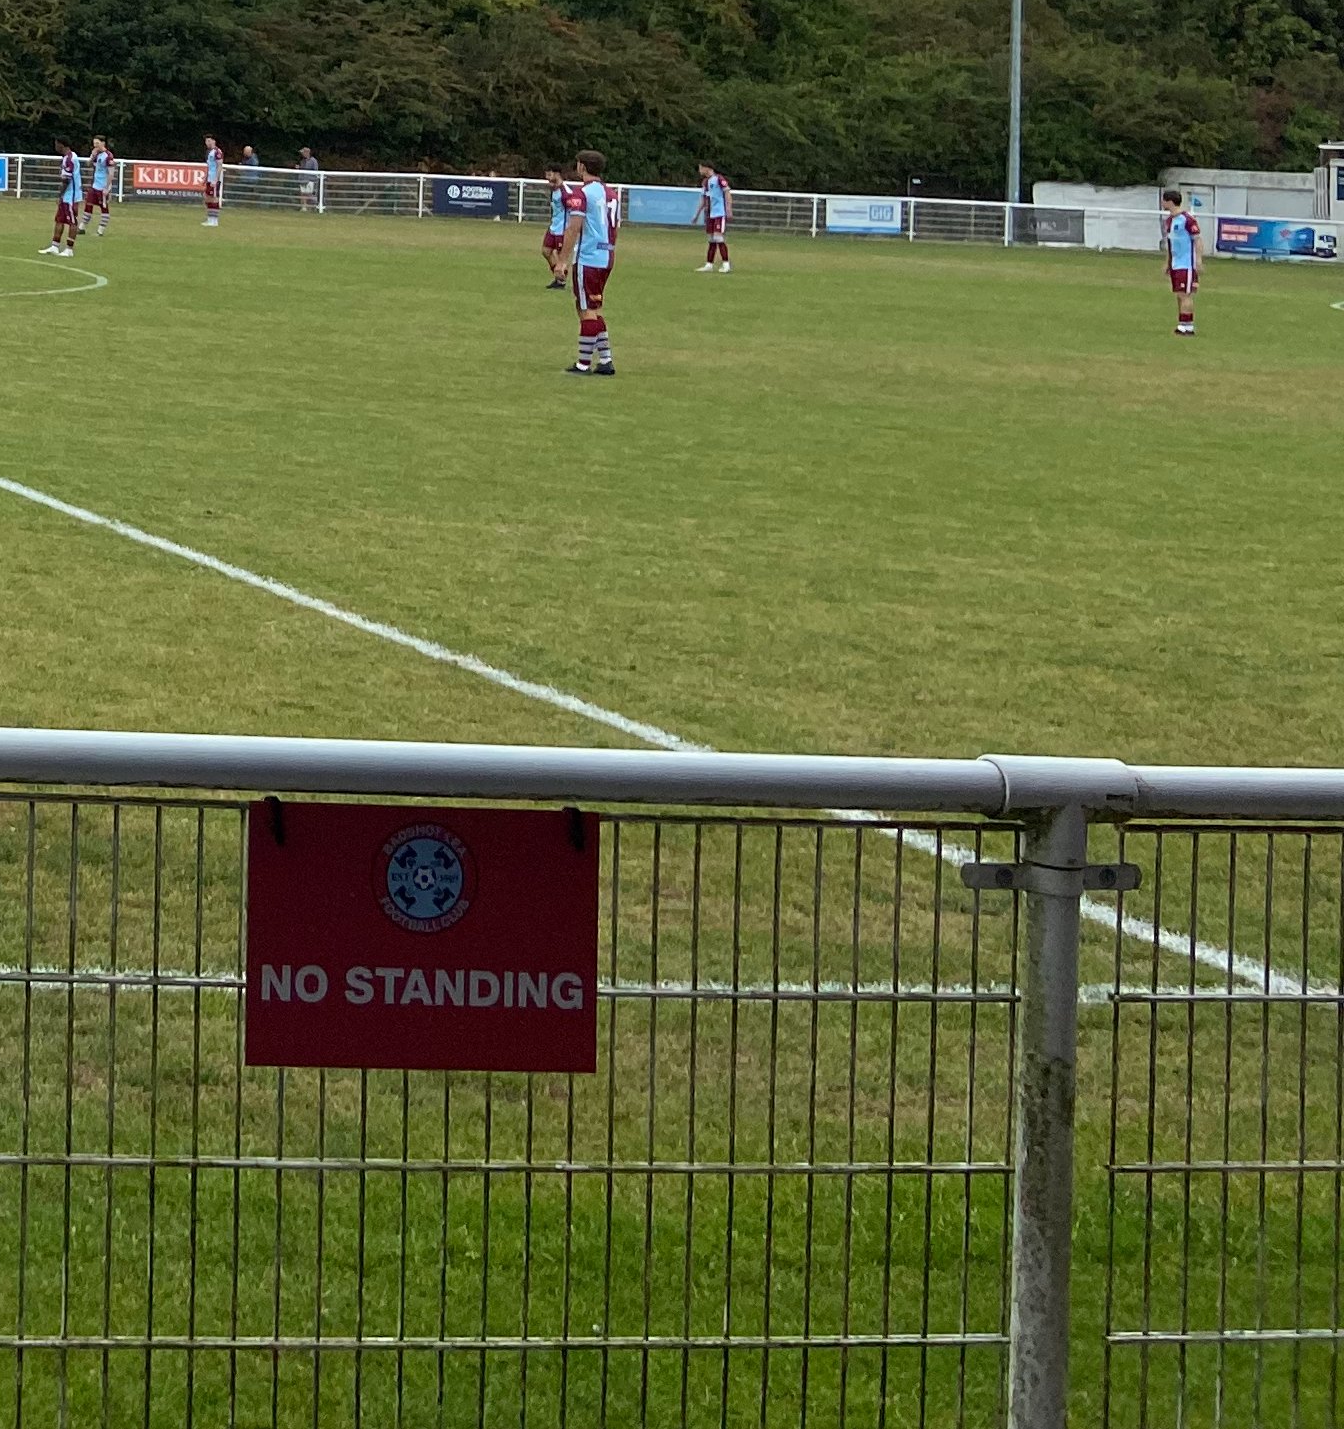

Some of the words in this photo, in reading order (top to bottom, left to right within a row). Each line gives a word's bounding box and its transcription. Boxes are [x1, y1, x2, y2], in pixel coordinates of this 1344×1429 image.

[137, 167, 206, 185] KEBUR
[261, 964, 329, 1003] NO
[344, 966, 584, 1010] STANDING
